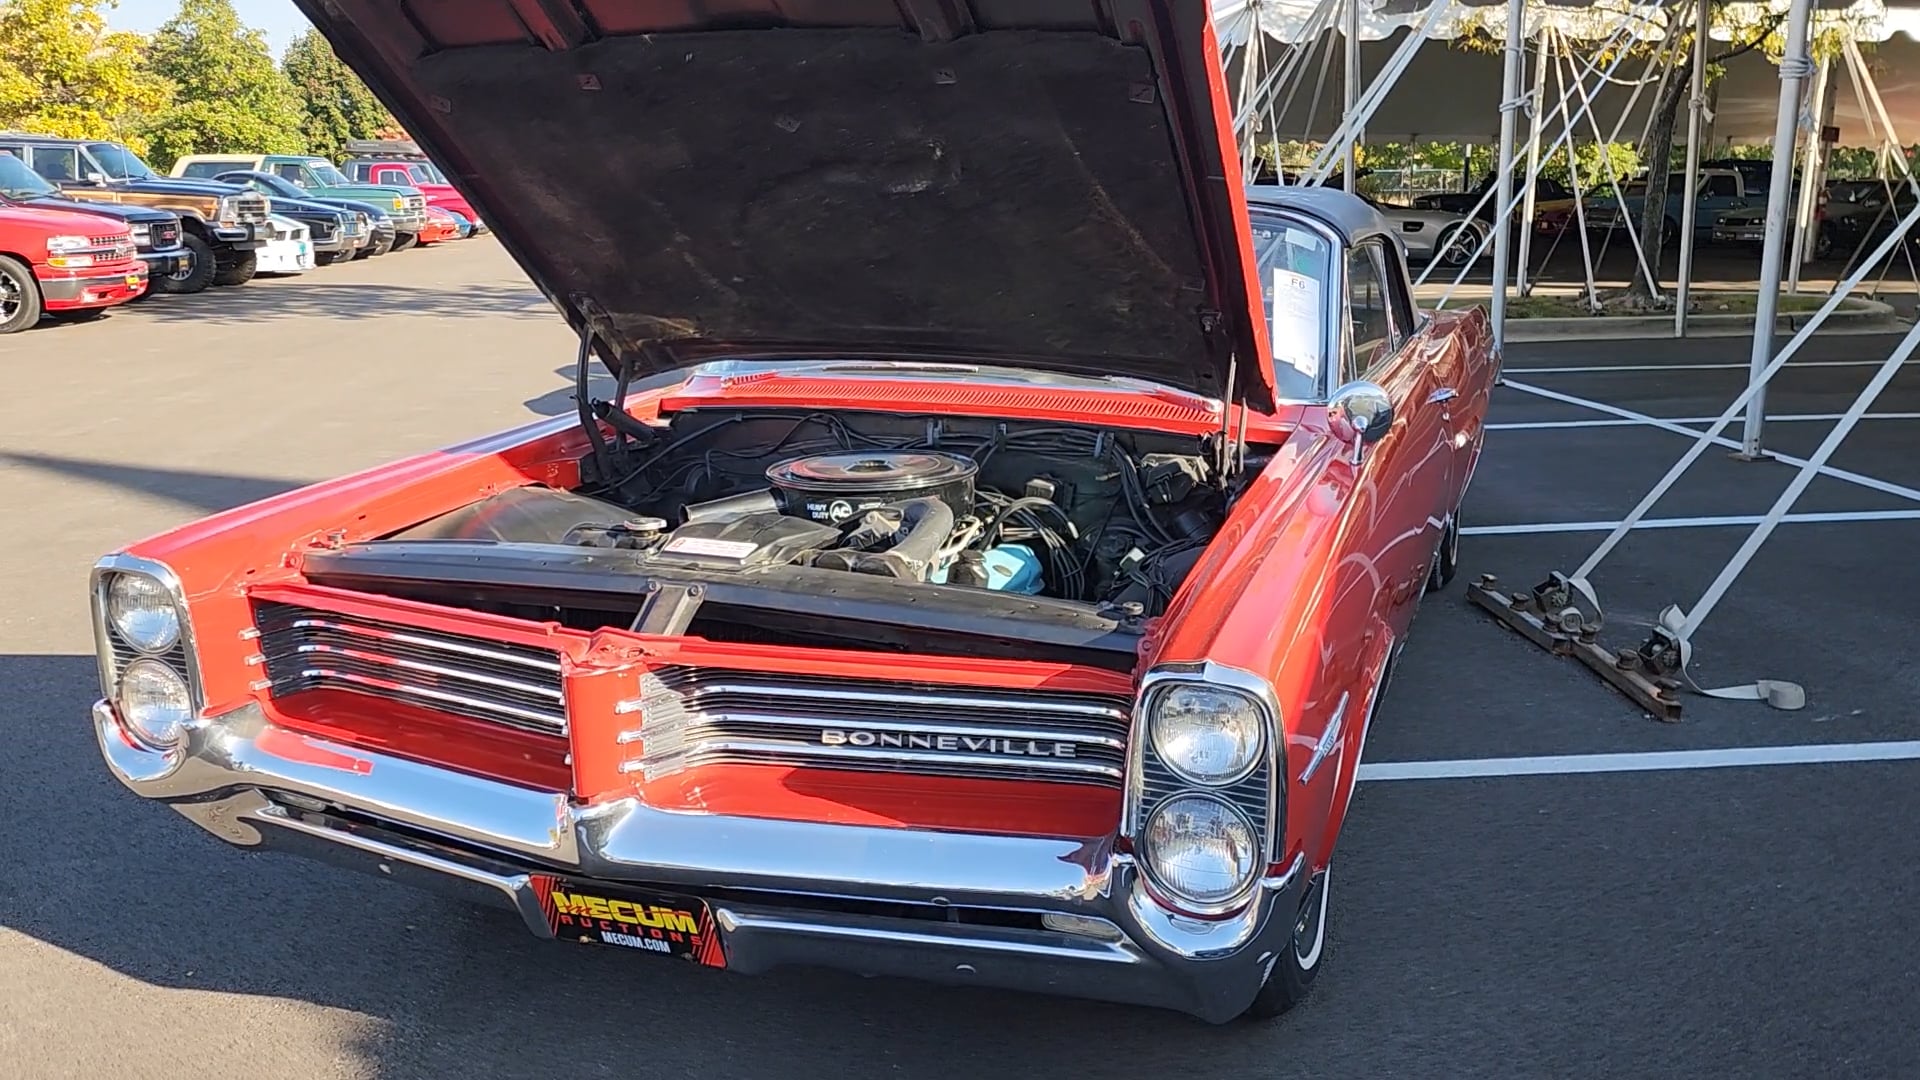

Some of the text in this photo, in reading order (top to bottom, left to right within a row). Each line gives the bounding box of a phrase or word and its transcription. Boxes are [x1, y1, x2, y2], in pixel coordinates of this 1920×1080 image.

[806, 503, 827, 511] HEAVY
[811, 511, 829, 520] DUTY
[820, 728, 1077, 758] BONNEVILLE
[551, 891, 699, 935] MECUM
[560, 915, 703, 946] AUCTIONS
[600, 930, 672, 954] MECUM.COM
